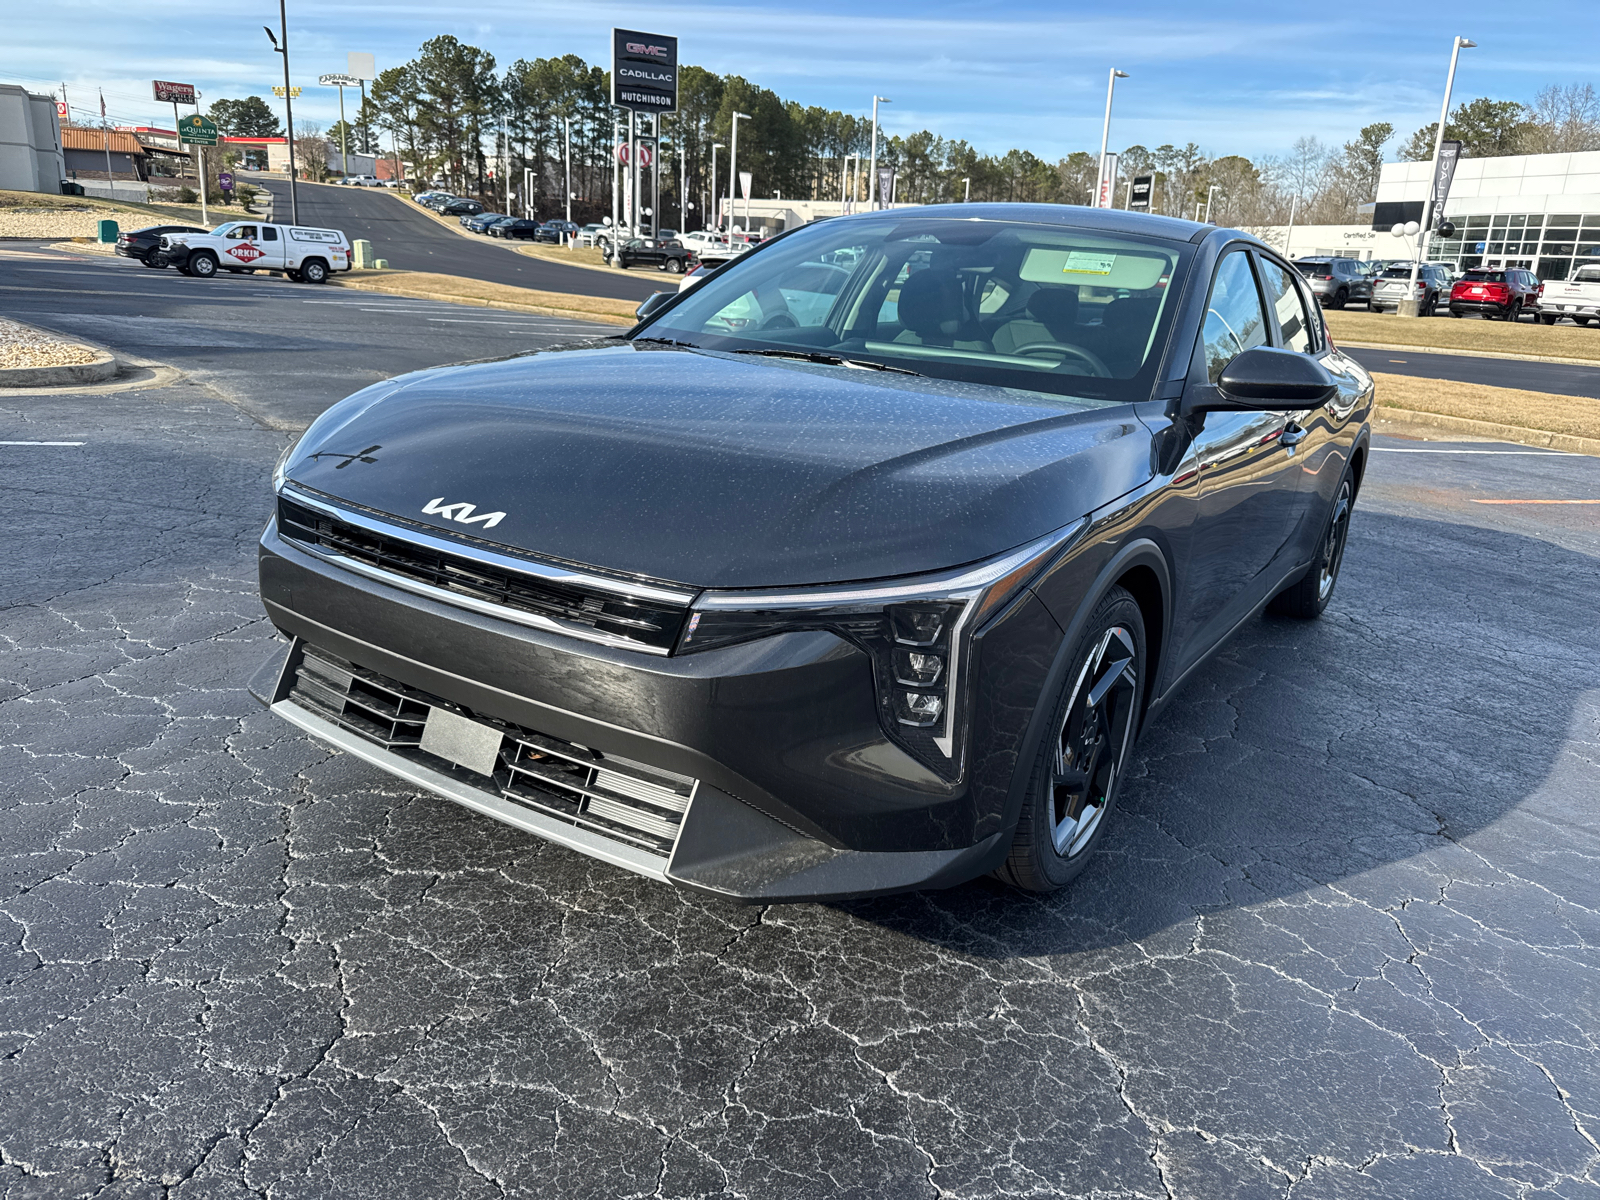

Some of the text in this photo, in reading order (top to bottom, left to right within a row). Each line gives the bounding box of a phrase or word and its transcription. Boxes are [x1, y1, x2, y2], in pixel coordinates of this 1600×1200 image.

[626, 42, 668, 57] GMC
[619, 68, 673, 82] CADILLAC
[156, 81, 193, 94] Wagers
[621, 91, 672, 106] HUTCHINSON
[186, 125, 216, 135] QUINTA
[230, 248, 260, 258] ORKIN
[421, 497, 507, 529] KIA
